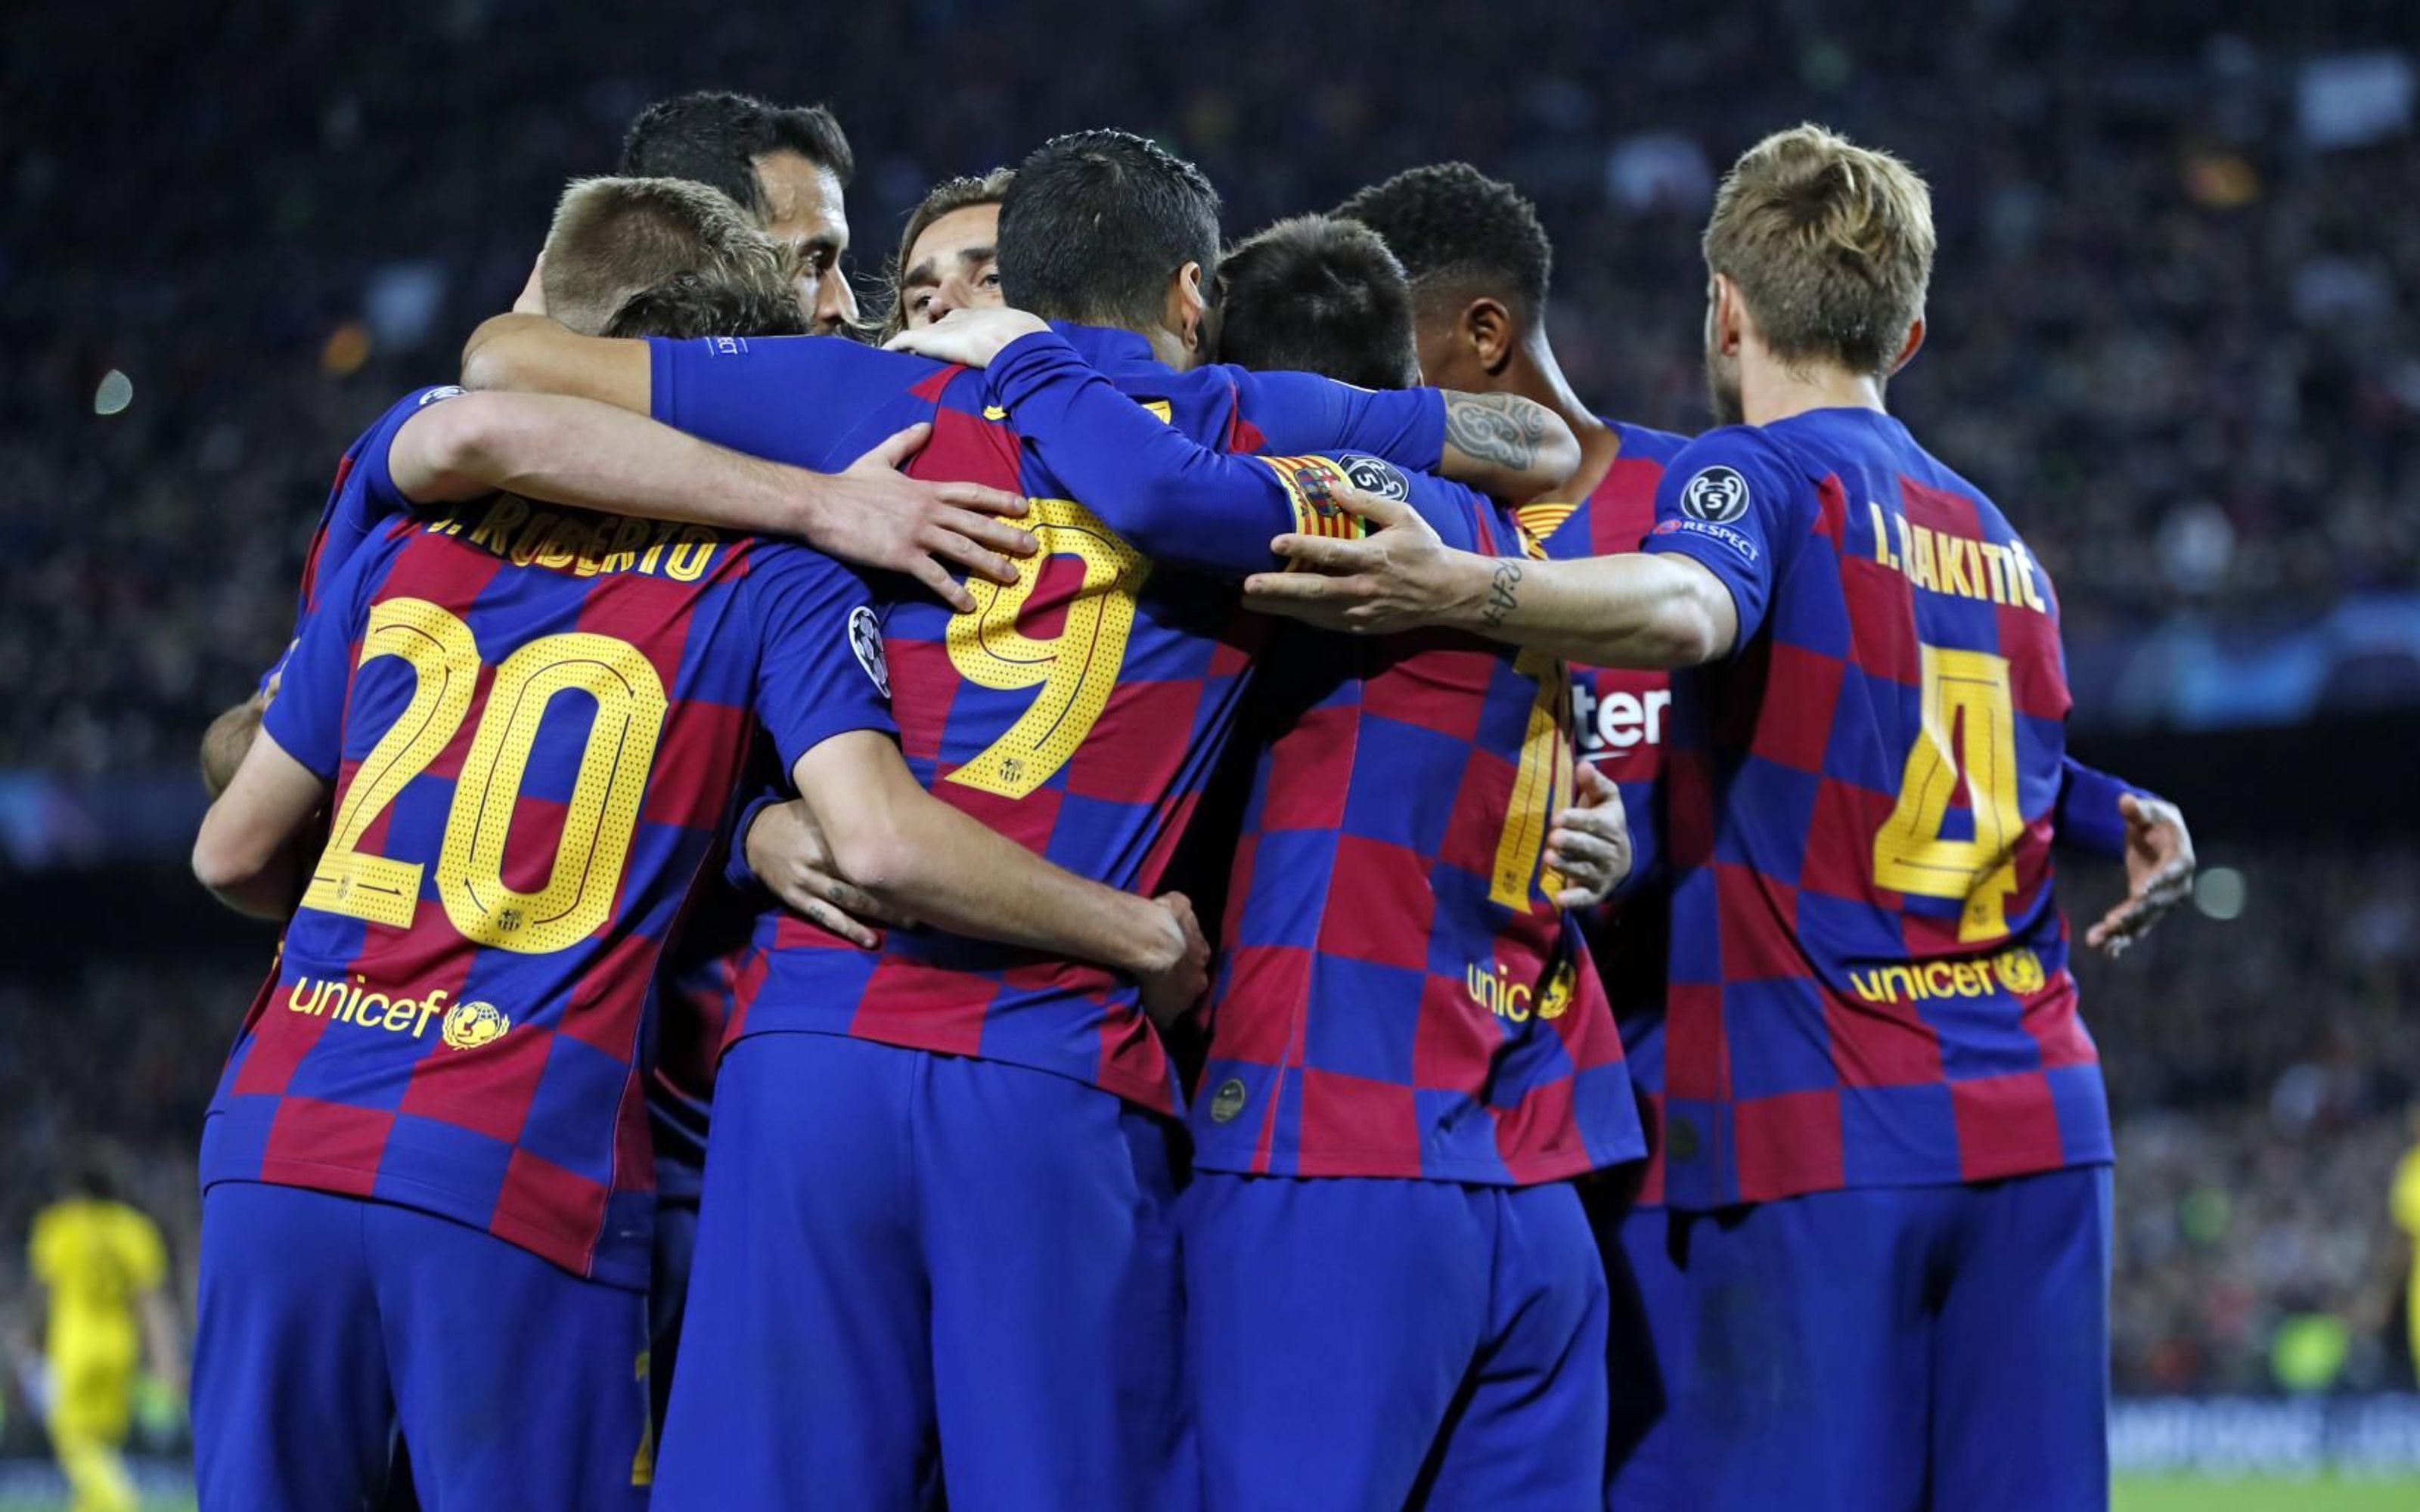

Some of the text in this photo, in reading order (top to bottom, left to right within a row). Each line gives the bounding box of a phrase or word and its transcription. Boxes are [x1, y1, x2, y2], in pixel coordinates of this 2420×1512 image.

[1357, 472, 1378, 486] 5
[1706, 493, 1723, 508] 5
[469, 495, 719, 581] ROBERTO
[1683, 521, 1760, 561] RESPECT
[1869, 500, 1900, 571] I.
[945, 497, 1152, 800] 9
[299, 597, 669, 954] 20
[1488, 647, 1572, 914] 1
[1873, 643, 2024, 943] 4
[289, 974, 448, 1037] unicef
[1468, 963, 1531, 1022] unic
[1850, 959, 1995, 1004] unicef
